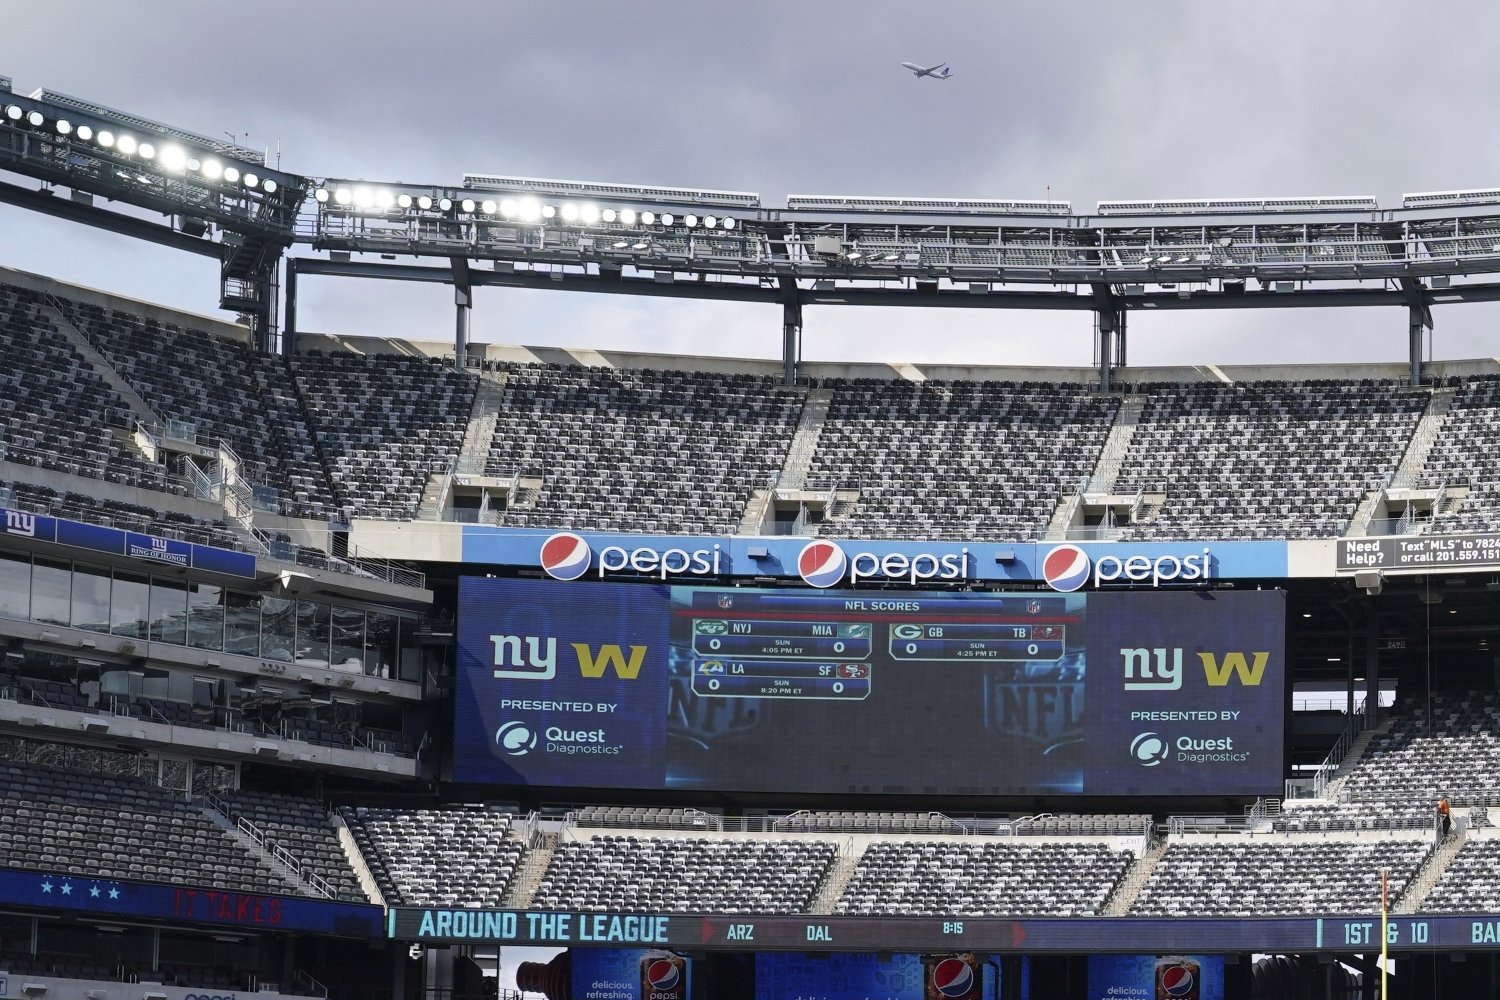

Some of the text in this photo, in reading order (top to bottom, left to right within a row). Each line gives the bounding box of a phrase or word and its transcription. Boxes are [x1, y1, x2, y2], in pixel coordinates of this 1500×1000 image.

[1346, 541, 1380, 552] Need
[1401, 542, 1423, 551] Text
[1462, 540, 1474, 549] to
[131, 547, 149, 556] RING
[161, 553, 187, 563] HONOR
[599, 544, 720, 579] pepsi
[1346, 553, 1384, 566] Help?
[1401, 554, 1413, 562] or
[1415, 551, 1434, 562] call
[851, 547, 968, 584] pepsi
[1094, 547, 1210, 587] pepsi
[845, 601, 919, 611] NFL SCORES
[733, 623, 832, 636] NYJ MIA
[929, 628, 1026, 638] GB TB
[732, 663, 832, 676] LA SF
[501, 699, 618, 714] PRESENTED BY
[1131, 711, 1241, 721] PRESENTED BY
[546, 727, 605, 743] Quest
[546, 742, 619, 756] Diagnostics
[1176, 736, 1233, 752] Quest
[1177, 751, 1246, 764] Diagnostics
[419, 910, 669, 942] AROUND THE LEAGUE
[727, 924, 754, 940] ARZ
[943, 922, 963, 934] 8:15
[807, 925, 832, 941] DAL
[1344, 923, 1372, 944] 1ST
[1411, 922, 1428, 944] 10
[592, 980, 635, 990] delicious.
[1107, 986, 1149, 995] delicious.
